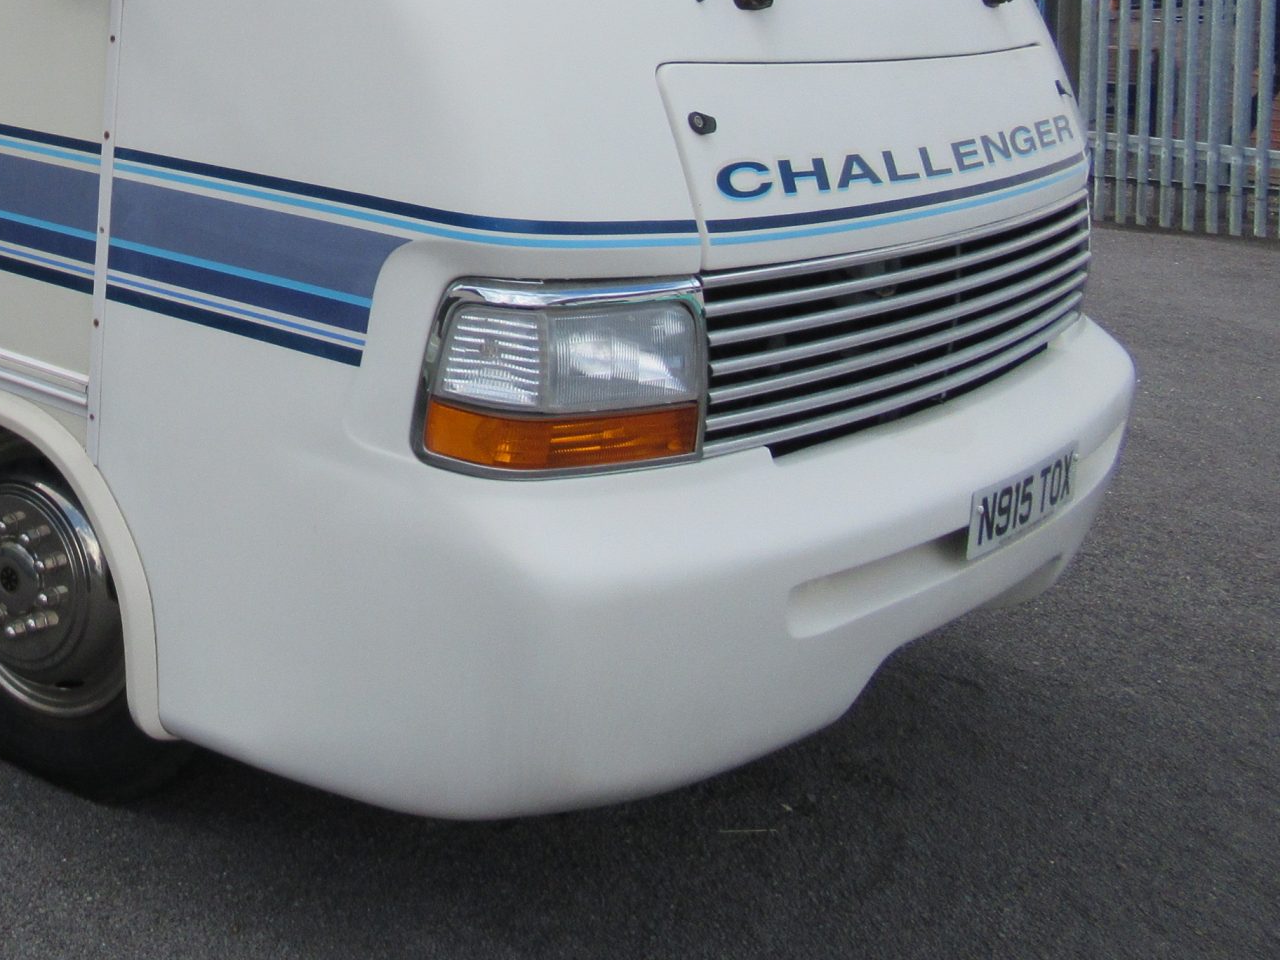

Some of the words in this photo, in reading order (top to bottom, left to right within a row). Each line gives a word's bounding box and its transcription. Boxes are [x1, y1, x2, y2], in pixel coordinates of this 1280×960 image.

[715, 114, 1074, 201] CHALLENGER
[978, 475, 1034, 546] N915
[1041, 450, 1073, 513] TOX
